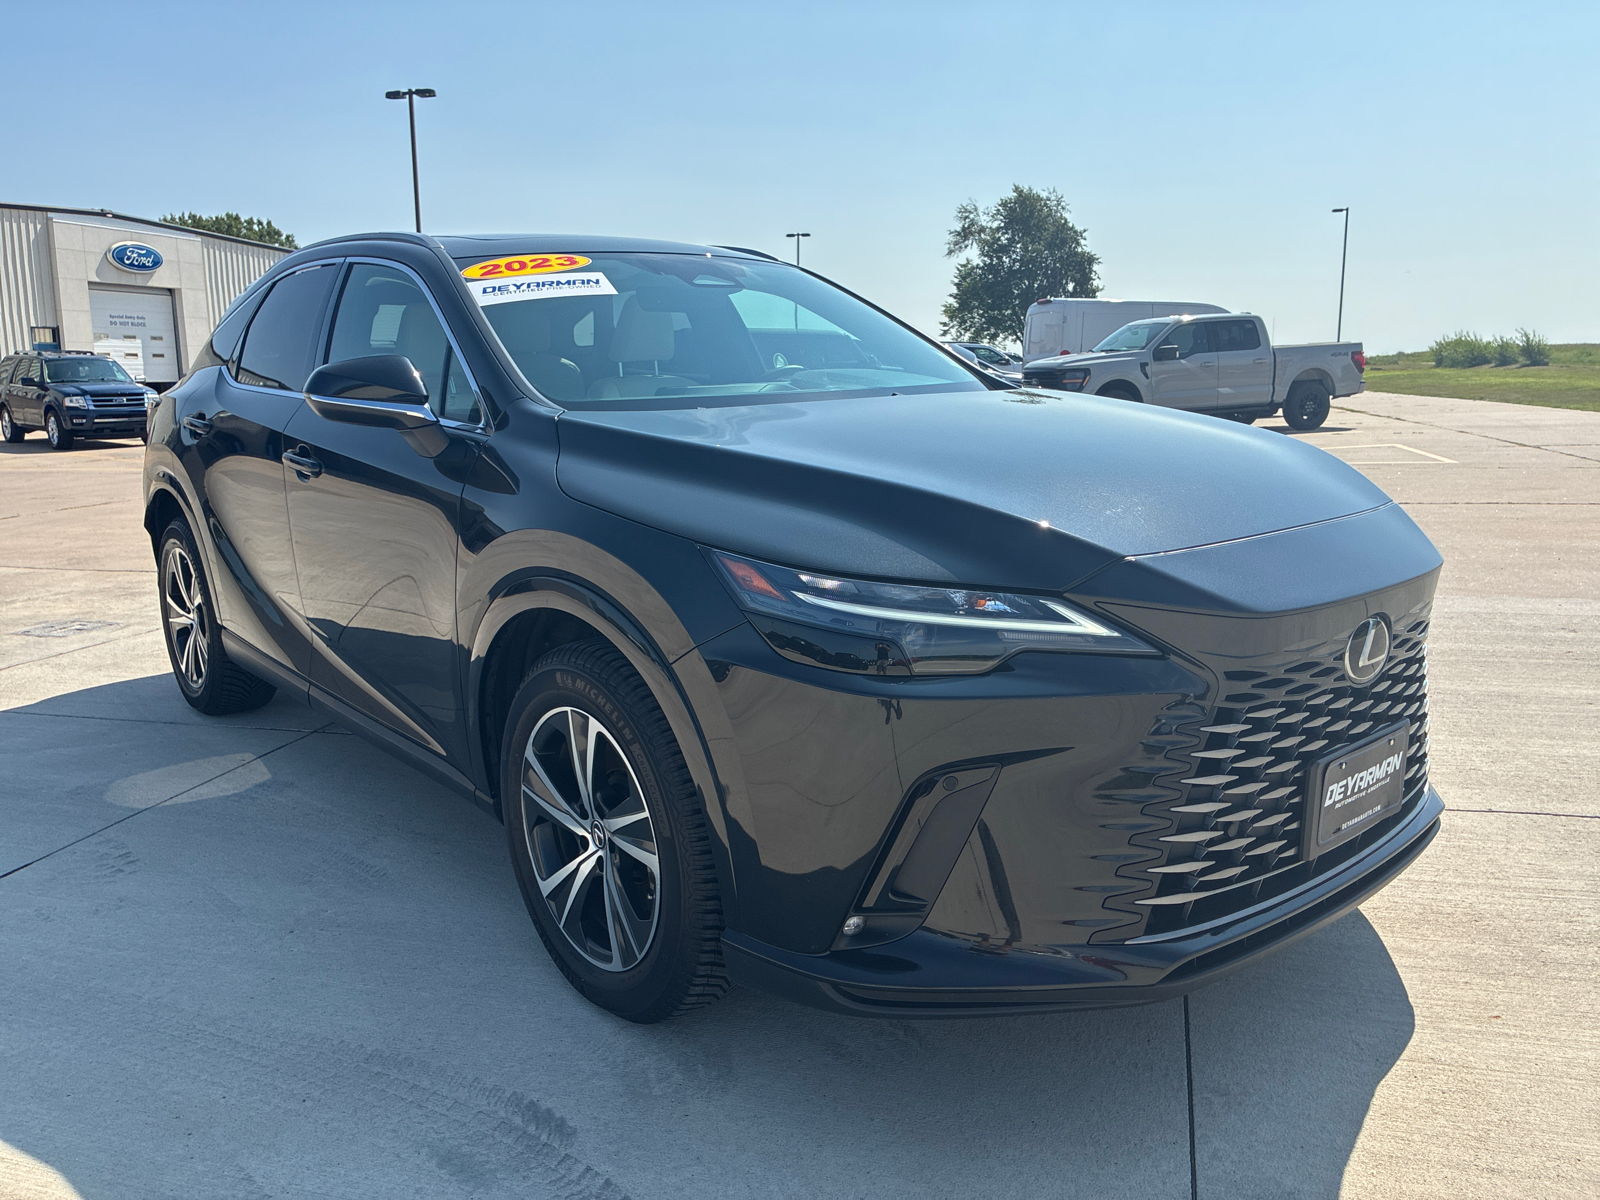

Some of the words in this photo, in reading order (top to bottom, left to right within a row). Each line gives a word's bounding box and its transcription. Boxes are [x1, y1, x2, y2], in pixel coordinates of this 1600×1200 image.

[124, 247, 154, 266] Ford
[479, 256, 580, 276] 2023
[482, 279, 600, 294] DEYARMAN
[493, 288, 543, 296] CERTIFIED
[575, 678, 633, 741] MICHELIN
[1323, 751, 1403, 808] DEYARMAN
